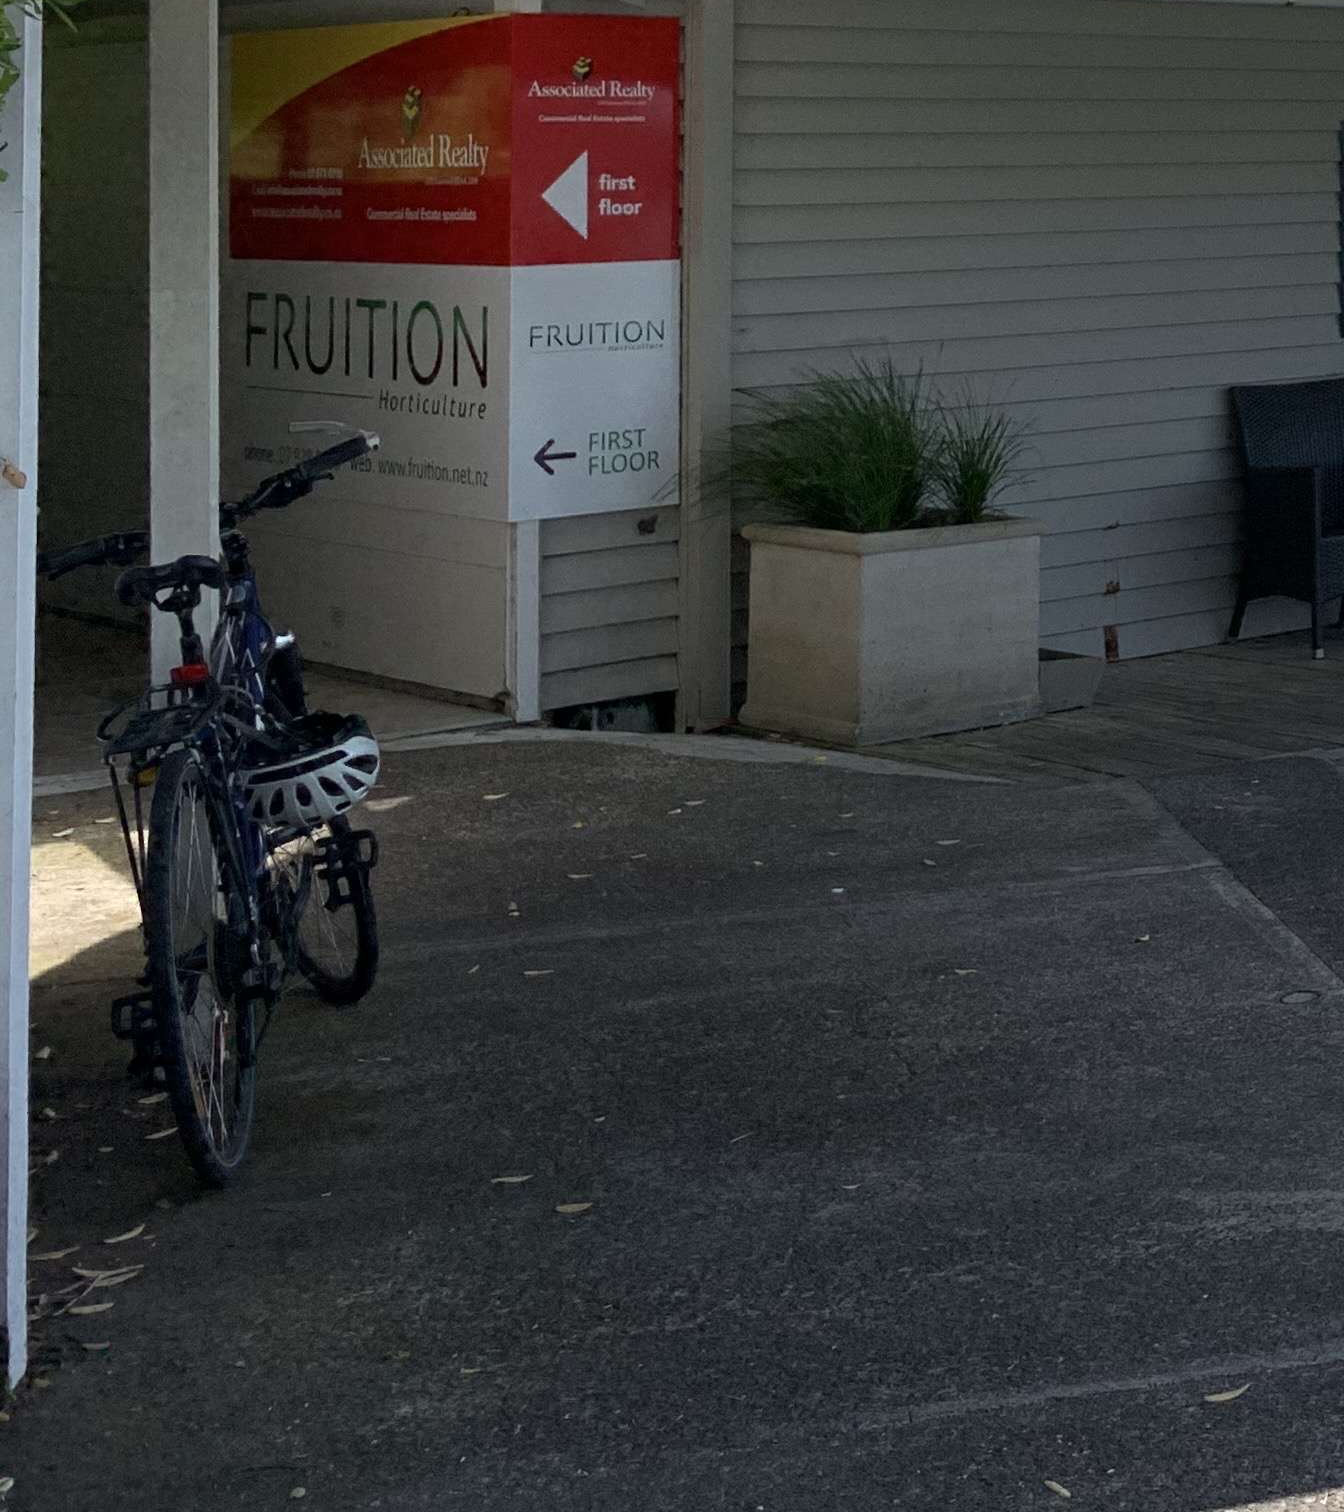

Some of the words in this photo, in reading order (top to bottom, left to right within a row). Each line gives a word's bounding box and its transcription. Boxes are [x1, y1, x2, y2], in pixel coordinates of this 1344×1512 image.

[528, 80, 606, 98] Associated
[609, 80, 655, 101] Realty
[358, 136, 434, 169] Associated
[438, 134, 489, 176] Realty
[598, 174, 636, 191] first
[598, 199, 643, 217] floor
[246, 292, 489, 389] FRUITION
[529, 320, 665, 348] FRUITION
[378, 390, 488, 420] Horticulture
[588, 429, 646, 452] FIRST
[588, 450, 661, 476] FLOOR
